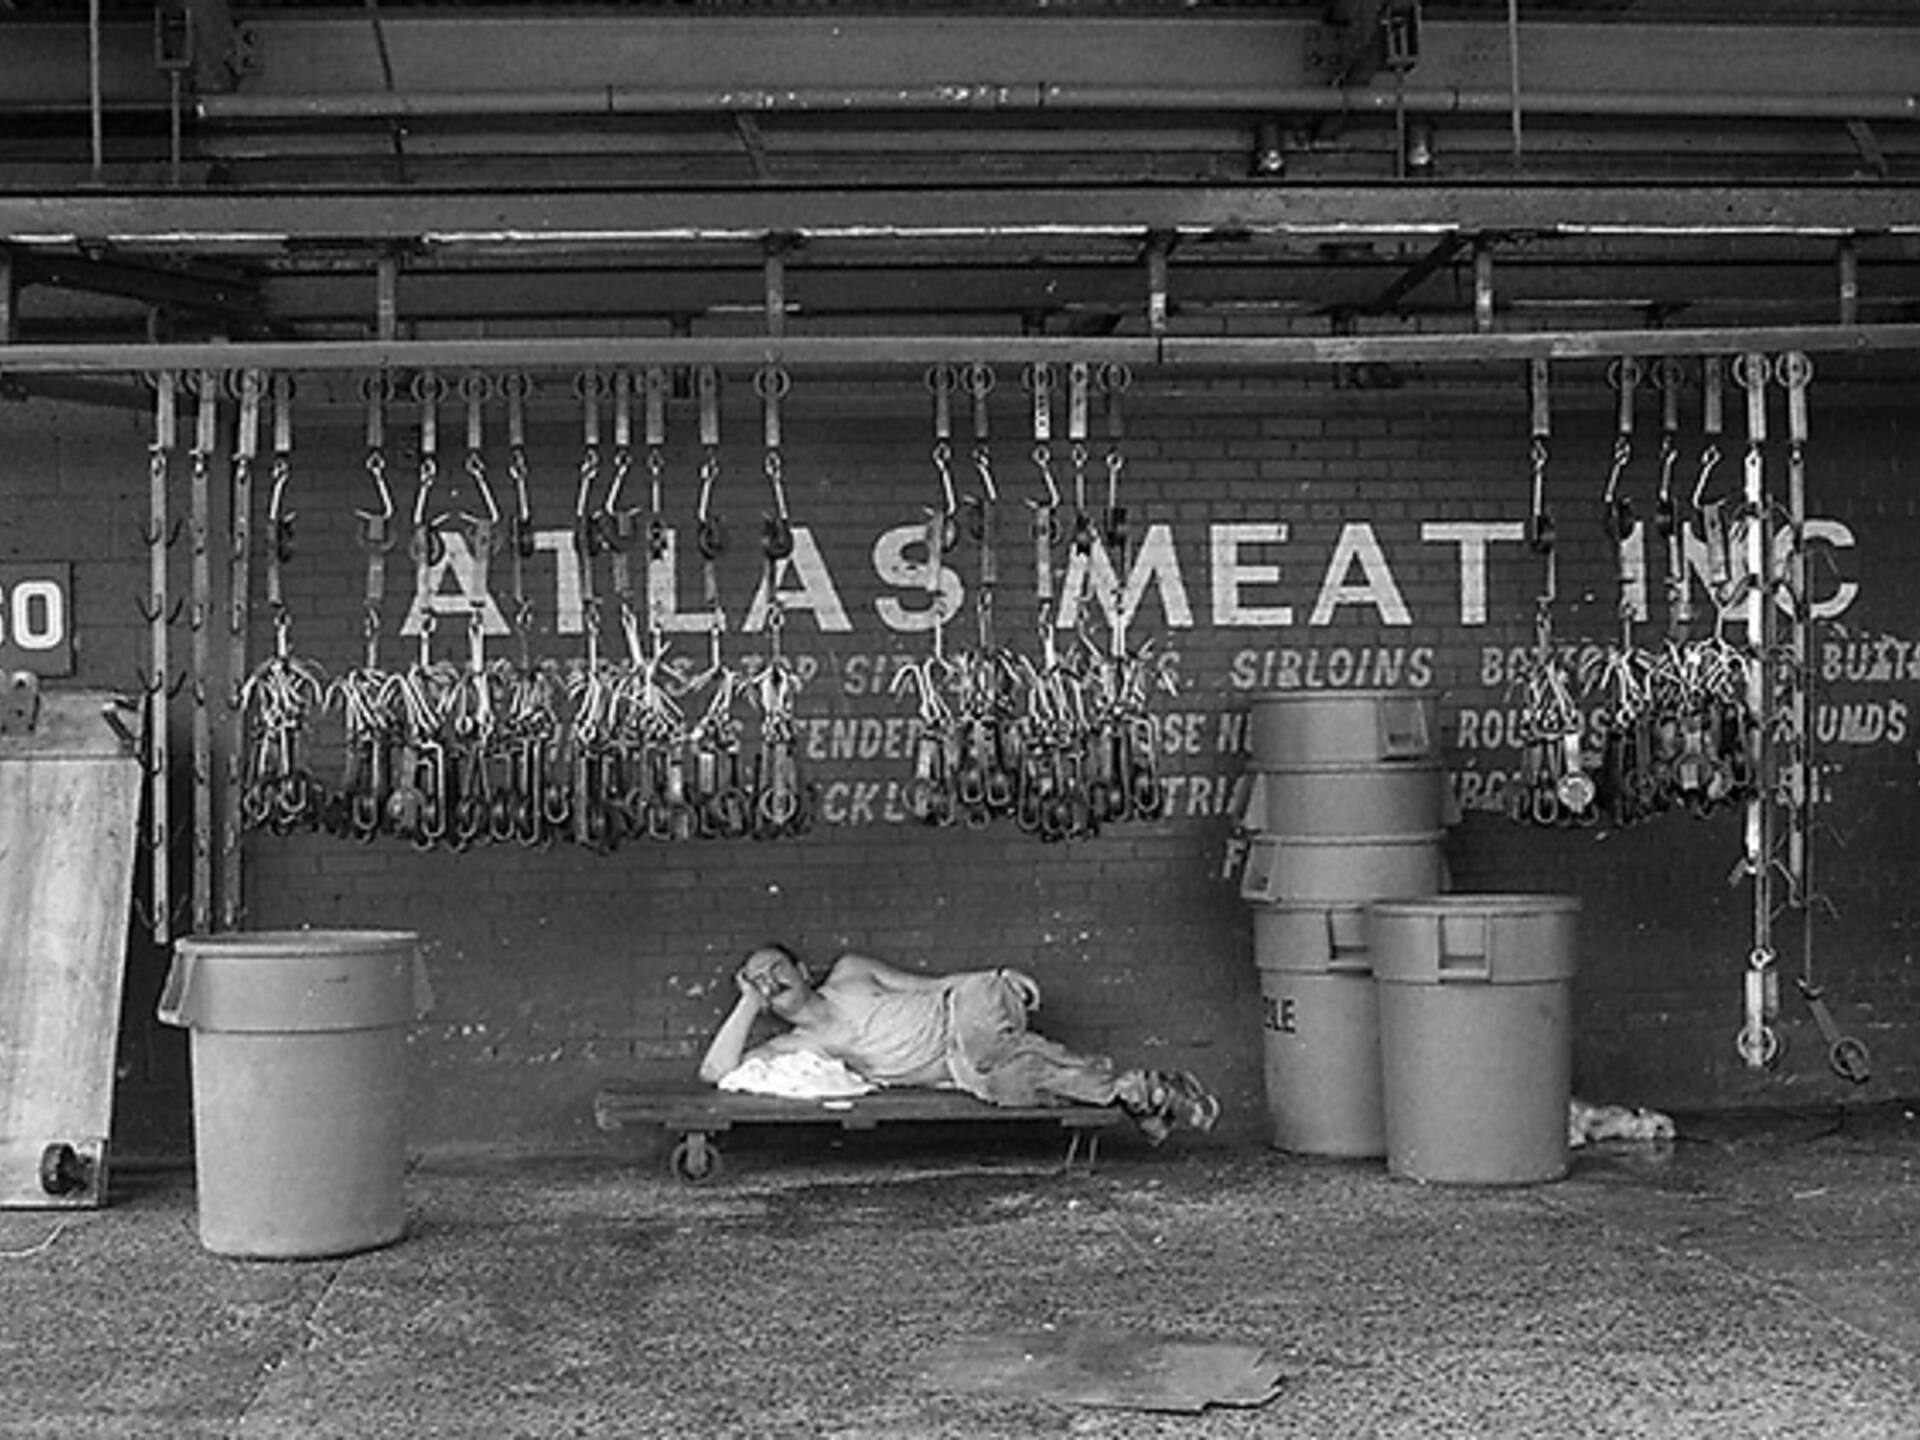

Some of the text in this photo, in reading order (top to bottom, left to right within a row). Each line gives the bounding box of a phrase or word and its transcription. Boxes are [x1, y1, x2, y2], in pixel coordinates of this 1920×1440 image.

[400, 517, 1858, 635] ATLAS MEAT INC
[0, 581, 64, 649] 0
[1229, 646, 1435, 690] SIRLOINS
